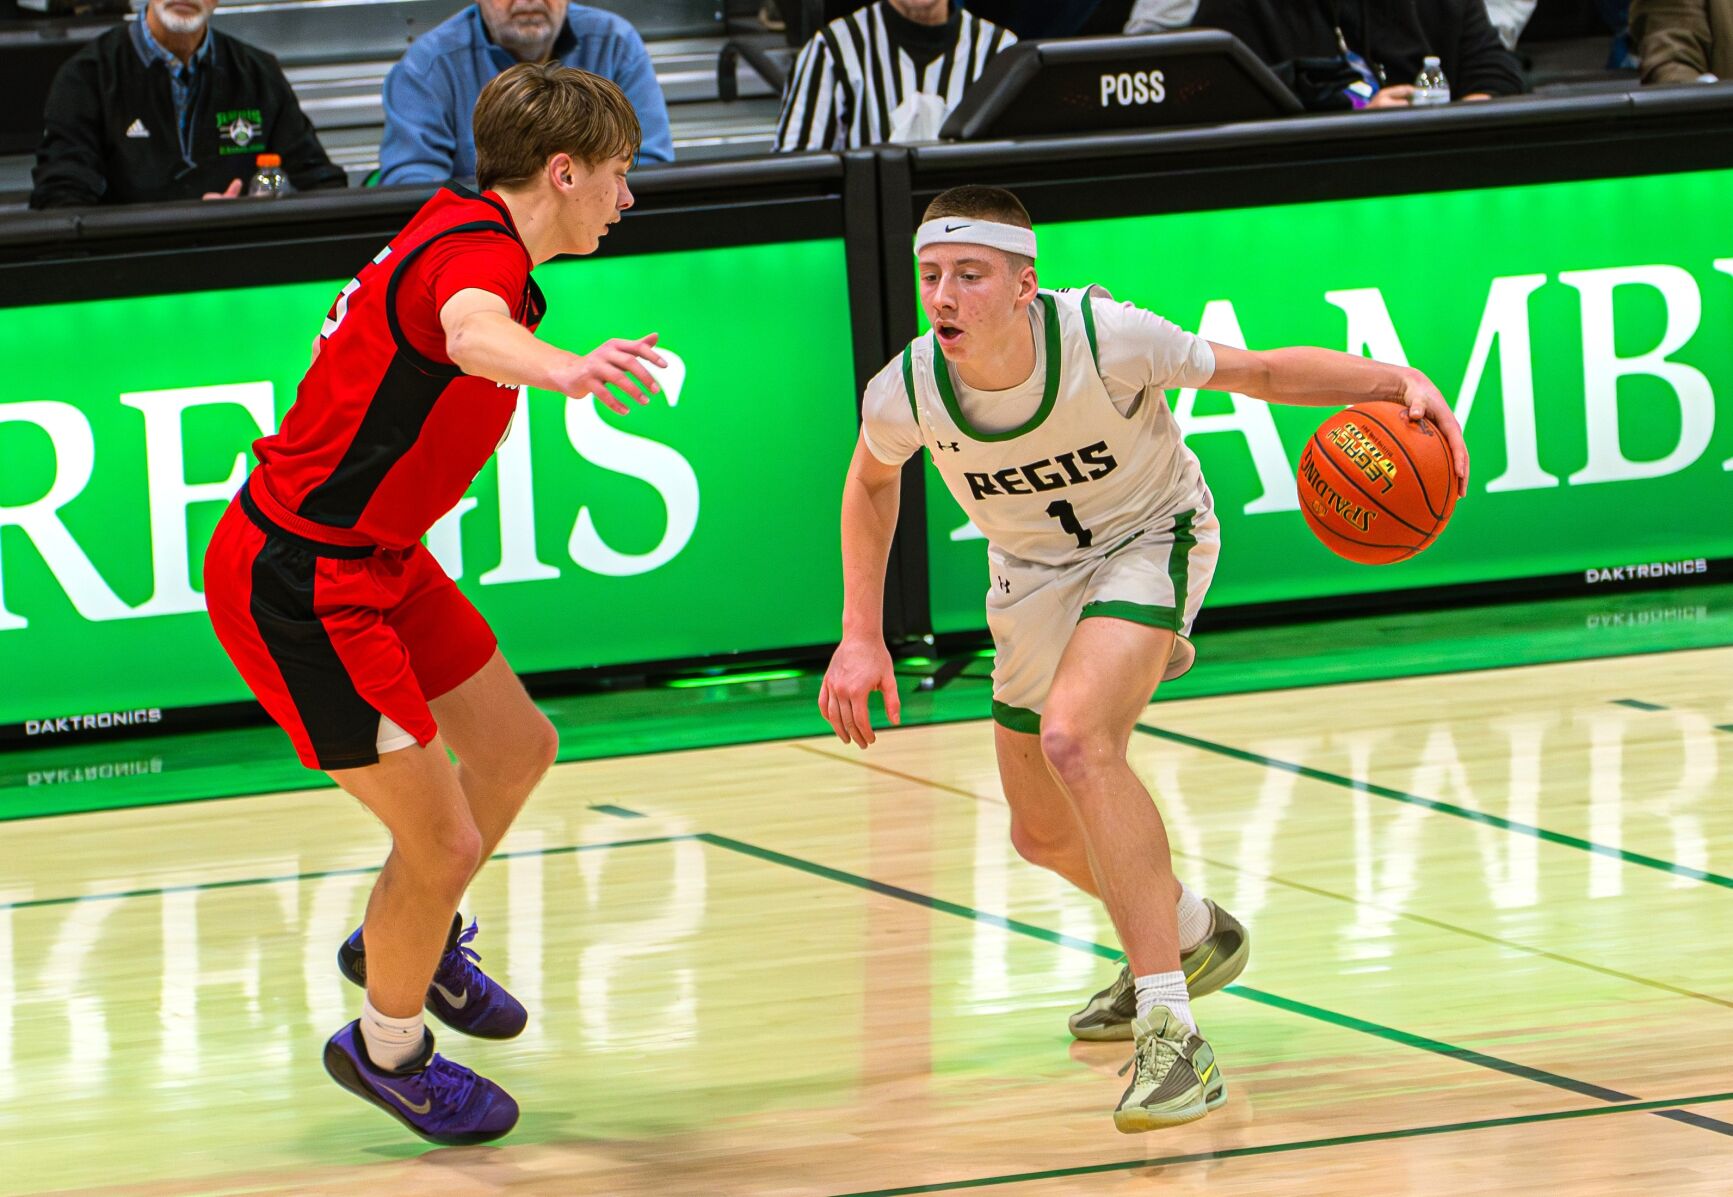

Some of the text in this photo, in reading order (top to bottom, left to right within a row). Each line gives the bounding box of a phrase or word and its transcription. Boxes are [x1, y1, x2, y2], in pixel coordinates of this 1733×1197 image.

[1101, 70, 1165, 107] POSS
[950, 258, 1733, 541] AMB
[963, 440, 1118, 500] REGIS
[1300, 442, 1377, 532] SPALDING
[1326, 422, 1395, 494] LEGACY
[0, 347, 700, 630] REIS
[1045, 499, 1093, 549] 1
[1585, 558, 1708, 583] DAKTRONICS
[25, 707, 163, 735] DAKTRONICS
